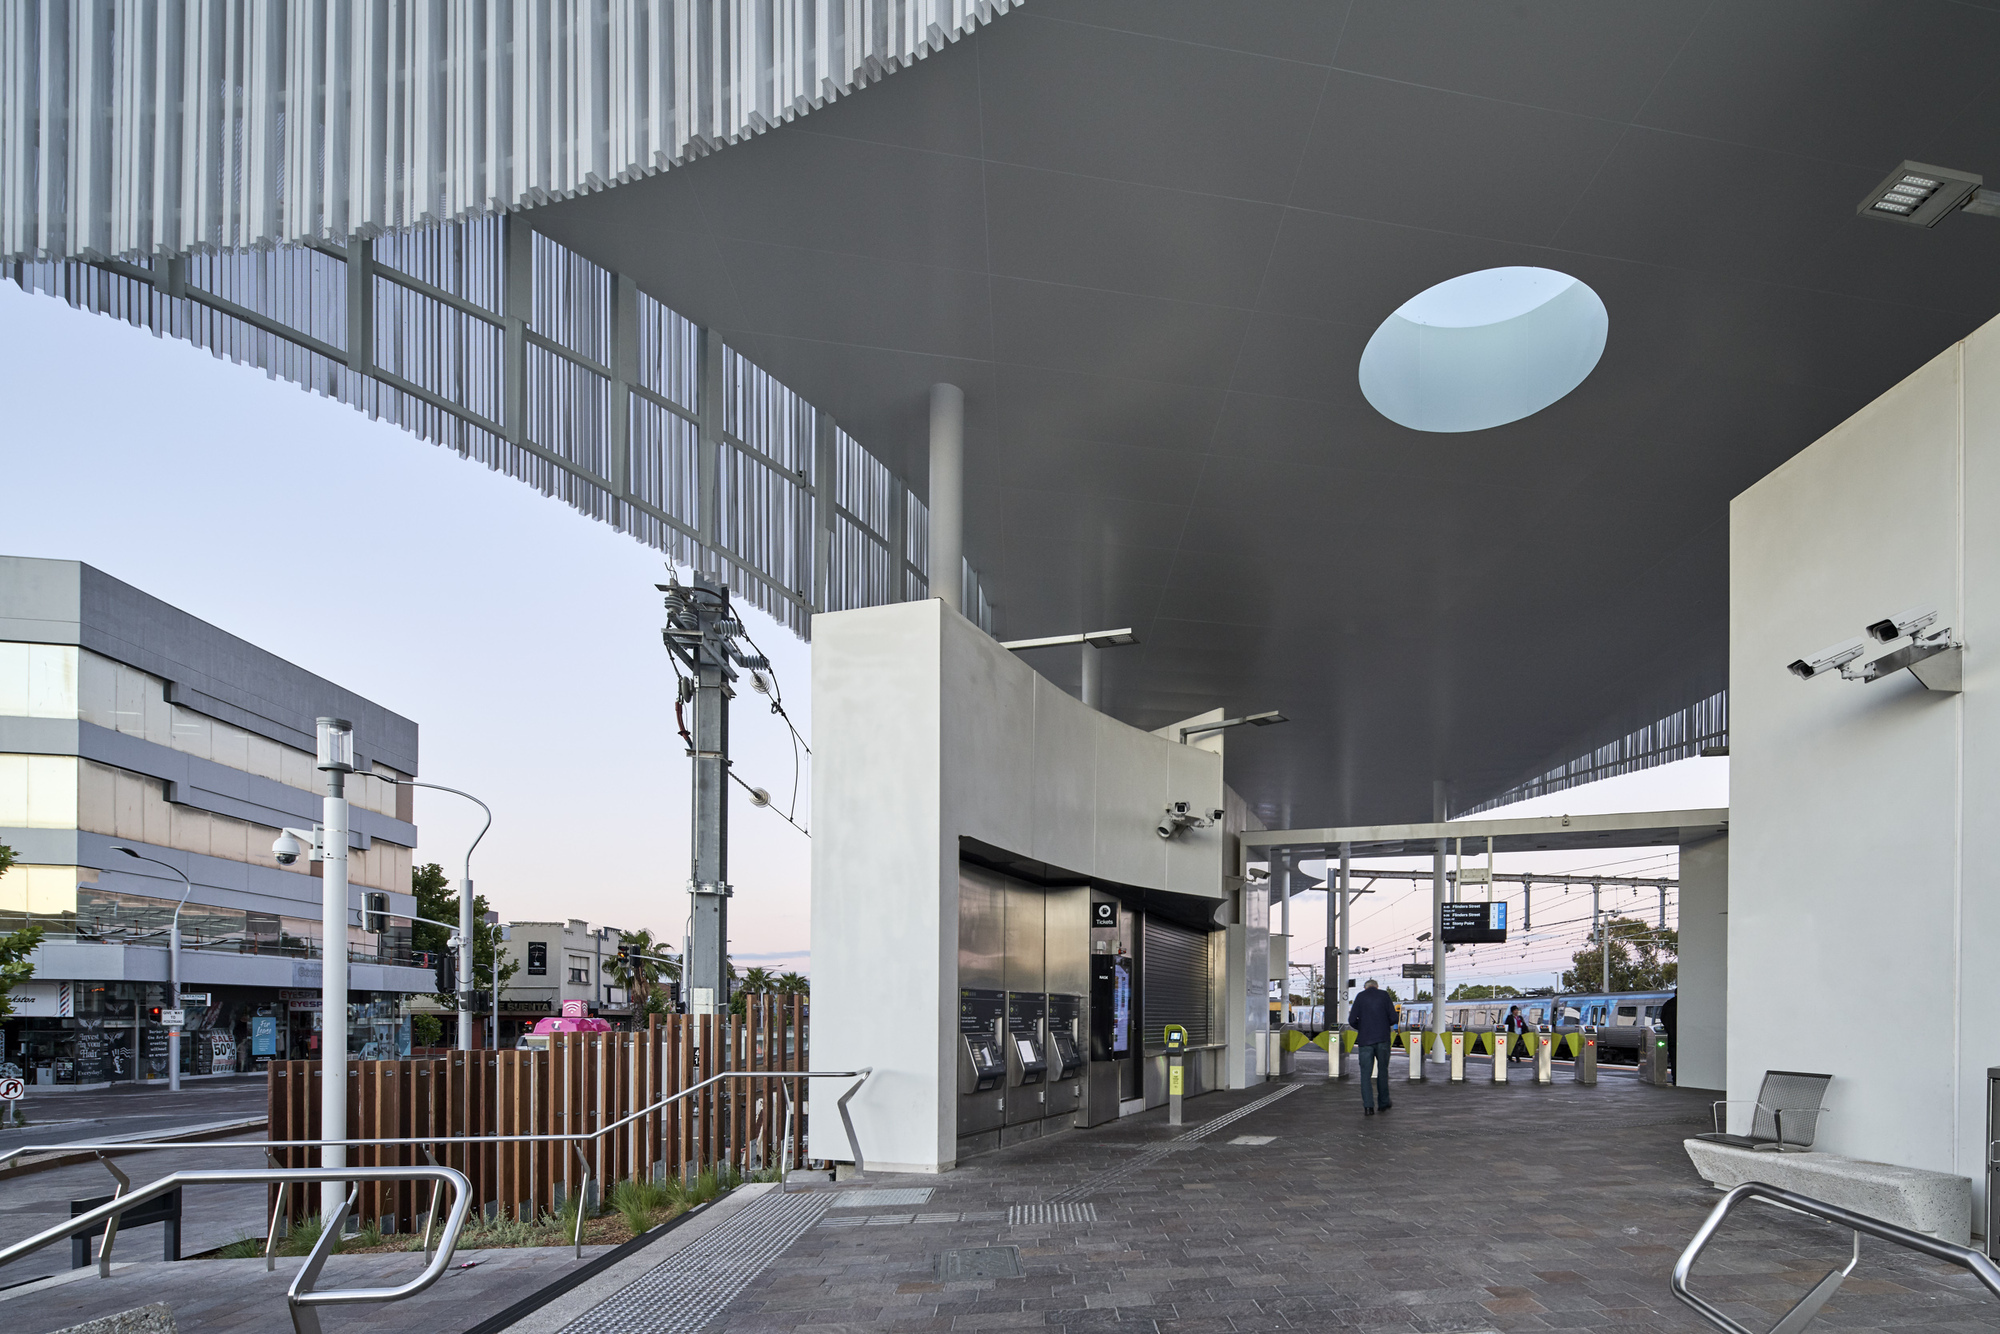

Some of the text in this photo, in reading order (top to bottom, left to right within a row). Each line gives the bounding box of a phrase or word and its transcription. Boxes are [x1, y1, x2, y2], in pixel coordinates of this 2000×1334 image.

[281, 991, 316, 999] EYESPY
[1342, 991, 1348, 1001] 3
[211, 1035, 234, 1043] SALE
[213, 1043, 235, 1056] 50%
